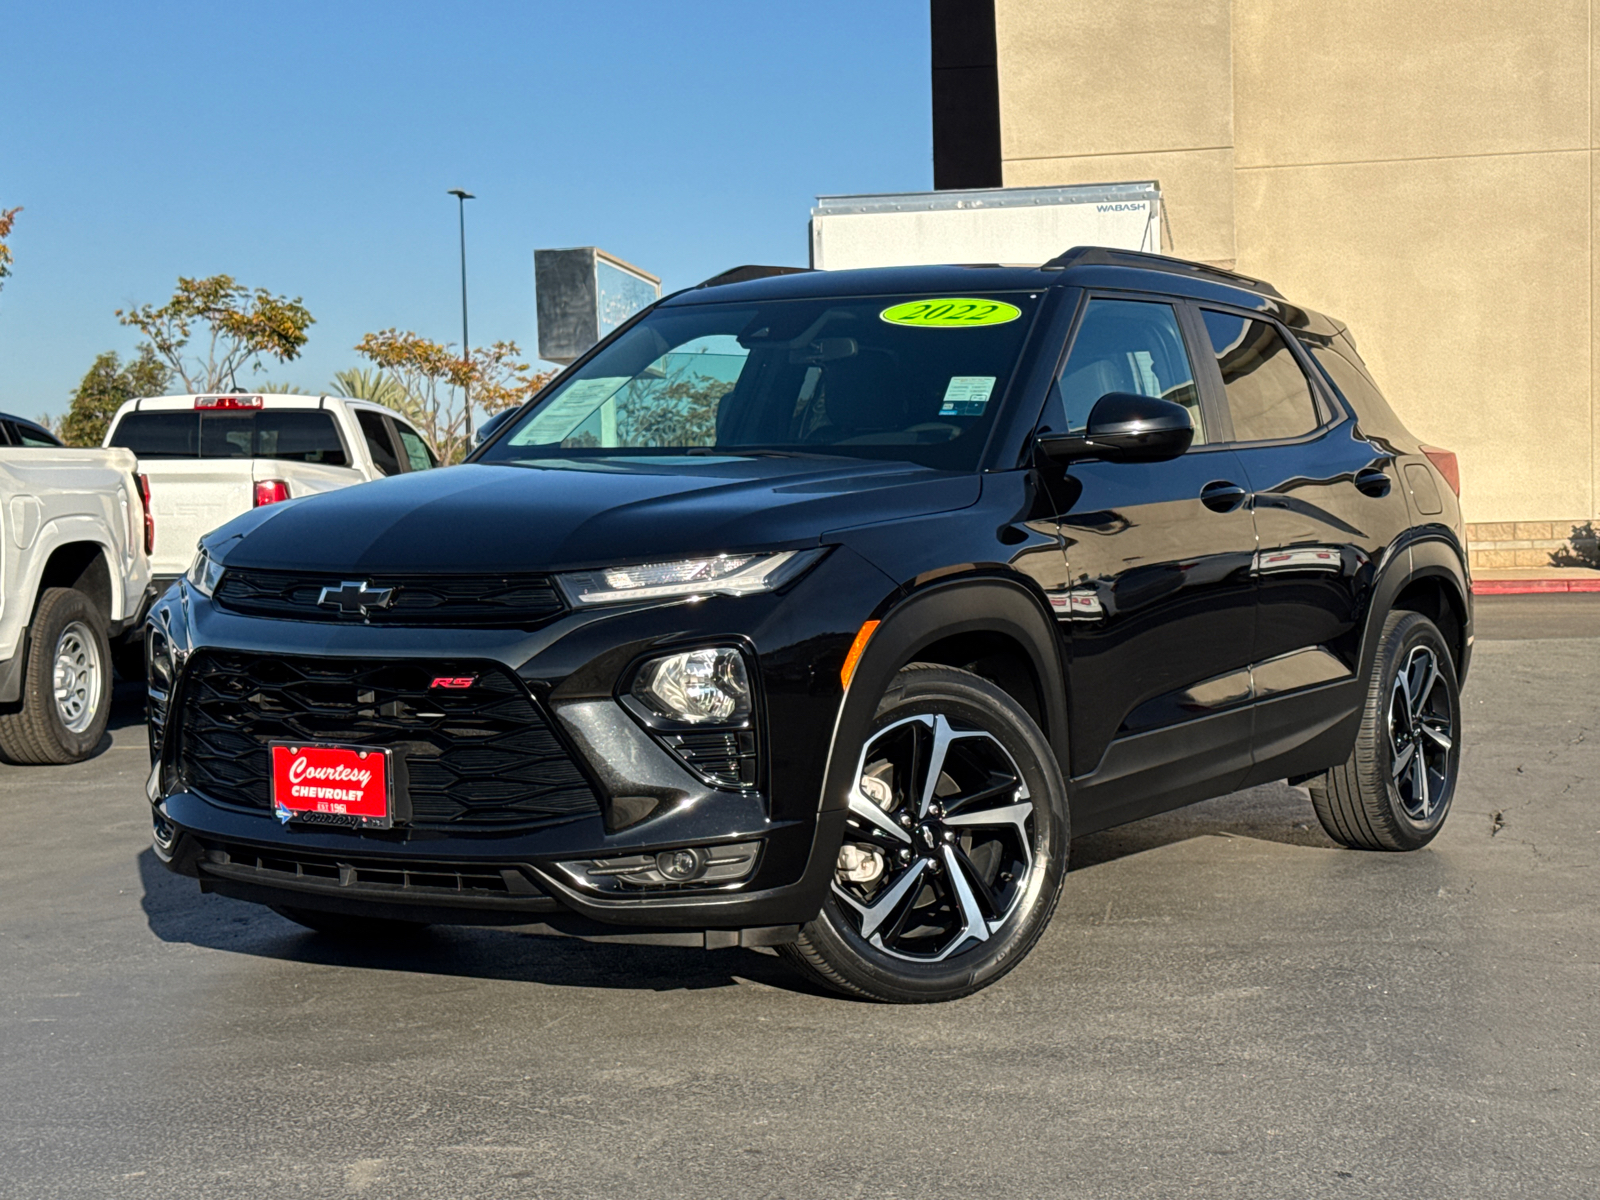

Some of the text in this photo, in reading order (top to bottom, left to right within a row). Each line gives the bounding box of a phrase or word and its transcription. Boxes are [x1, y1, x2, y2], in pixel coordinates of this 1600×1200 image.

[1096, 203, 1146, 213] WABASH
[898, 303, 999, 320] 2022
[430, 677, 474, 688] RS
[289, 756, 372, 788] Courtesy
[291, 785, 364, 802] CHEVROLET
[302, 810, 360, 830] Courtesy
